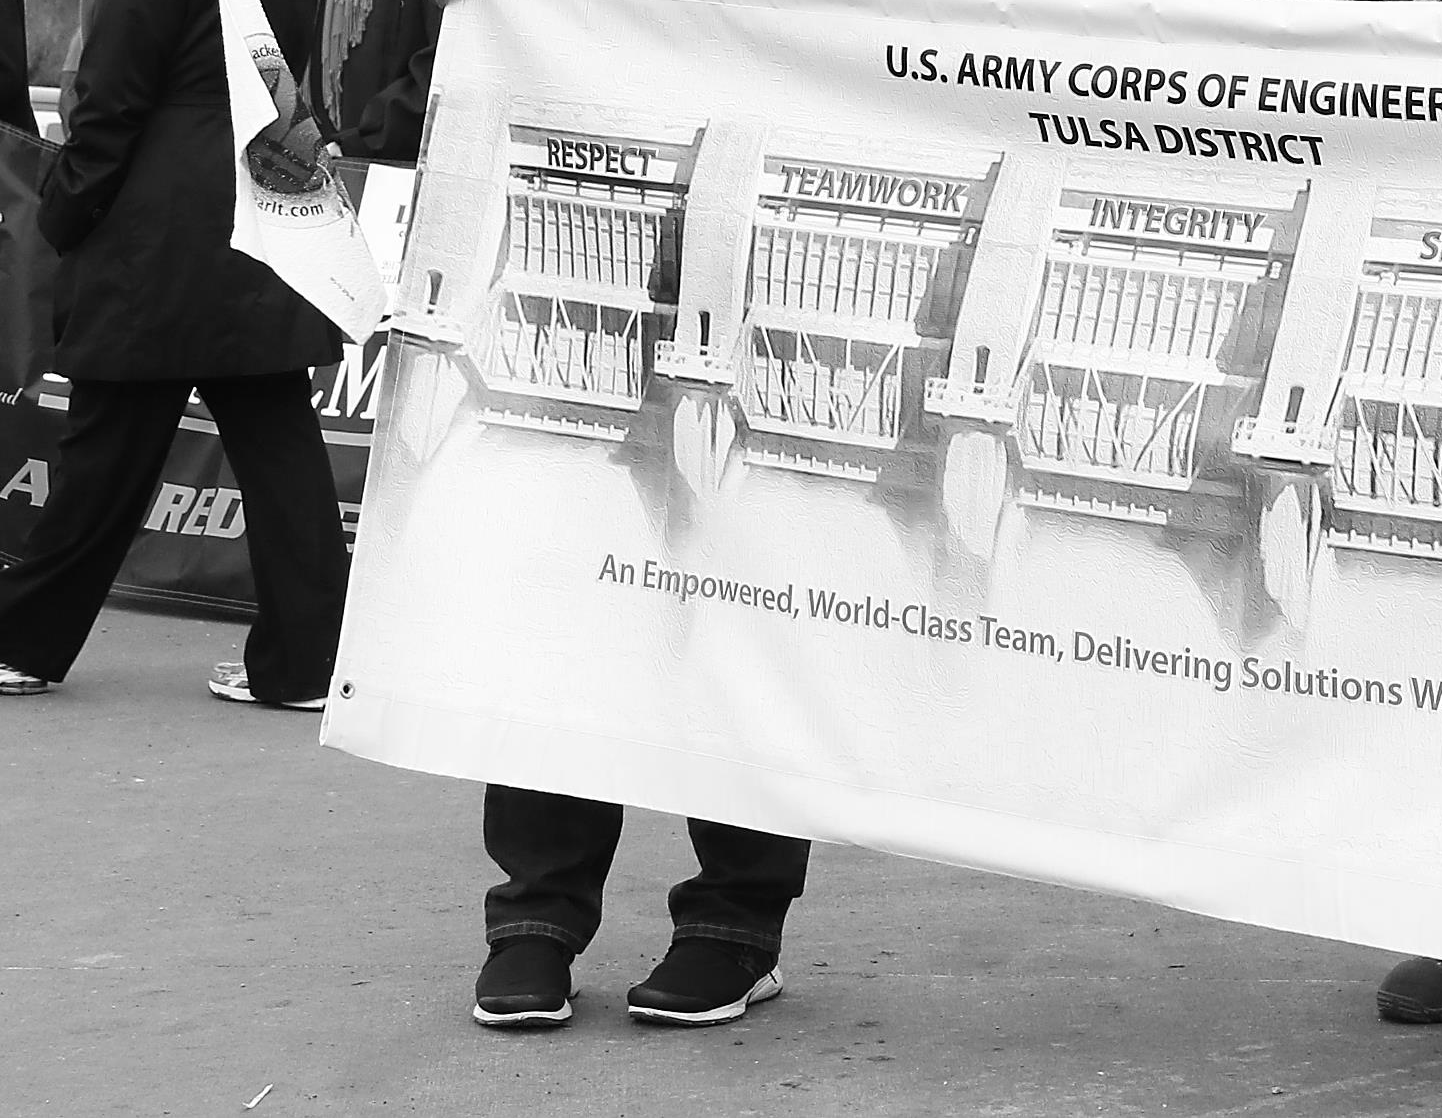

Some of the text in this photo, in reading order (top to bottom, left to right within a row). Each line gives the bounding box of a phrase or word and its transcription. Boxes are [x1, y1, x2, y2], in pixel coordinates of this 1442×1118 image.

[886, 44, 949, 84] U.S.
[956, 52, 1061, 94] ARMY
[1067, 63, 1187, 106] CORPS
[1198, 73, 1249, 111] OF
[546, 137, 658, 178] RESPECT
[1029, 112, 1323, 166] TULSA DISTRICT
[780, 163, 969, 214] TEAMWORK
[1089, 196, 1266, 244] INTEGRITY
[598, 553, 635, 584] An
[643, 560, 800, 620] Empowered,
[808, 588, 973, 644] World-Class
[980, 615, 1065, 663] Team,
[1073, 631, 1233, 692] Delivering
[1242, 657, 1403, 707] Solutions
